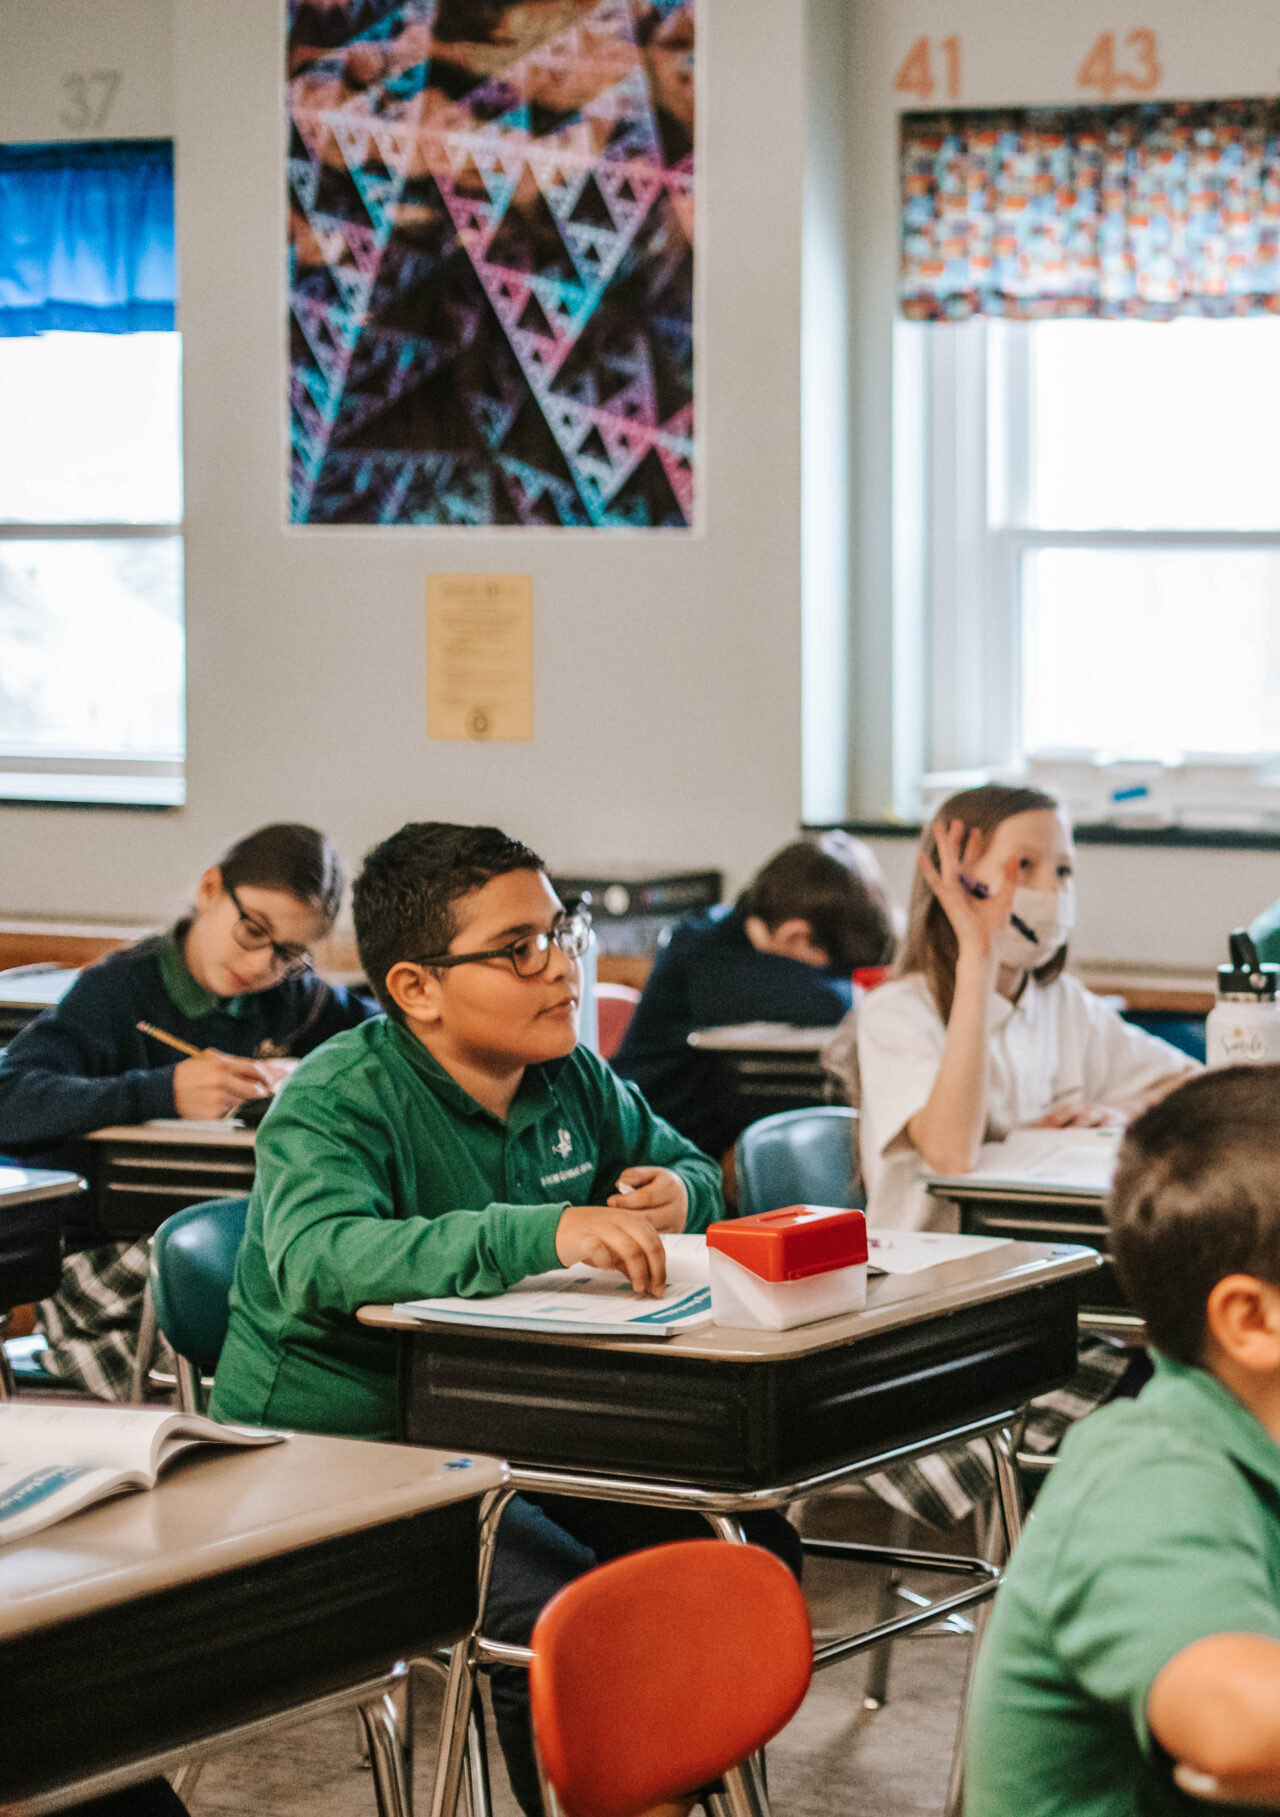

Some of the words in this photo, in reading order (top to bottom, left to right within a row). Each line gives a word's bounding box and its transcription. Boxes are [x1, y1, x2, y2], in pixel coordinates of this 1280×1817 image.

[894, 33, 963, 100] 41
[1075, 26, 1162, 97] 43
[58, 68, 122, 130] 37
